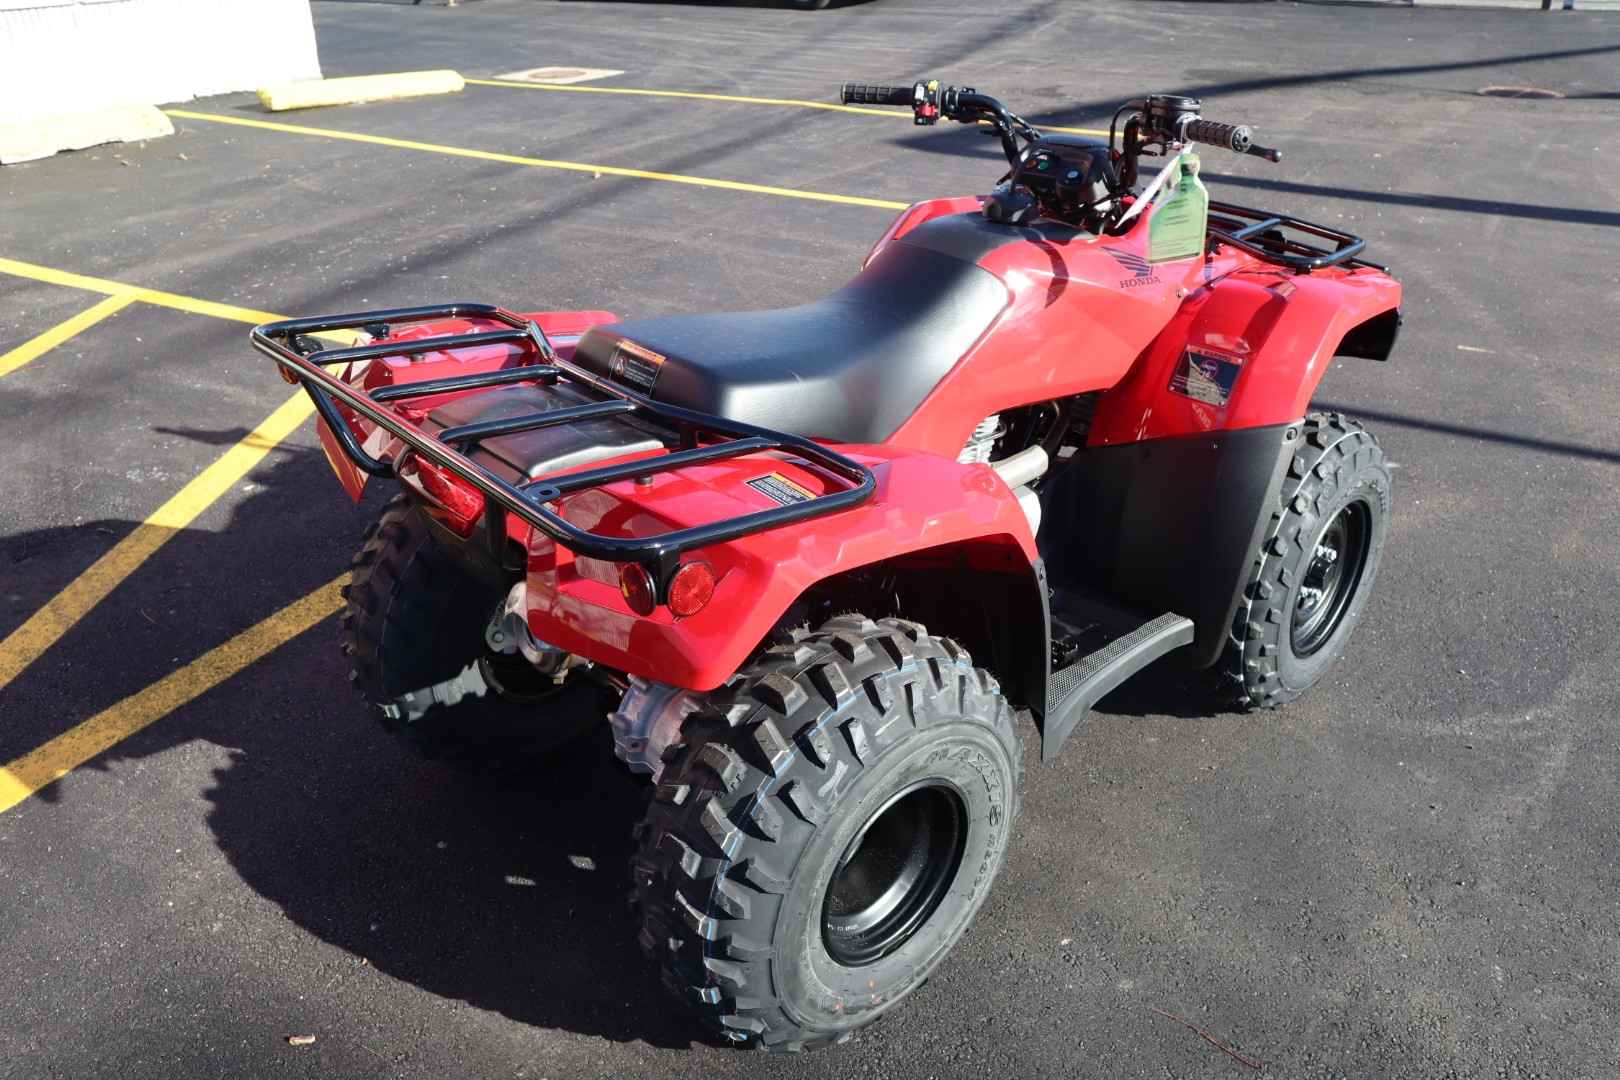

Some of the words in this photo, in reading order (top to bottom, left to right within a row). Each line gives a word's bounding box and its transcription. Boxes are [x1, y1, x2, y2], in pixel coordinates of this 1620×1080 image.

[1118, 276, 1162, 289] HONDA
[1204, 349, 1231, 362] WARNING
[1202, 371, 1212, 379] 16
[921, 744, 1002, 827] MAXXIS
